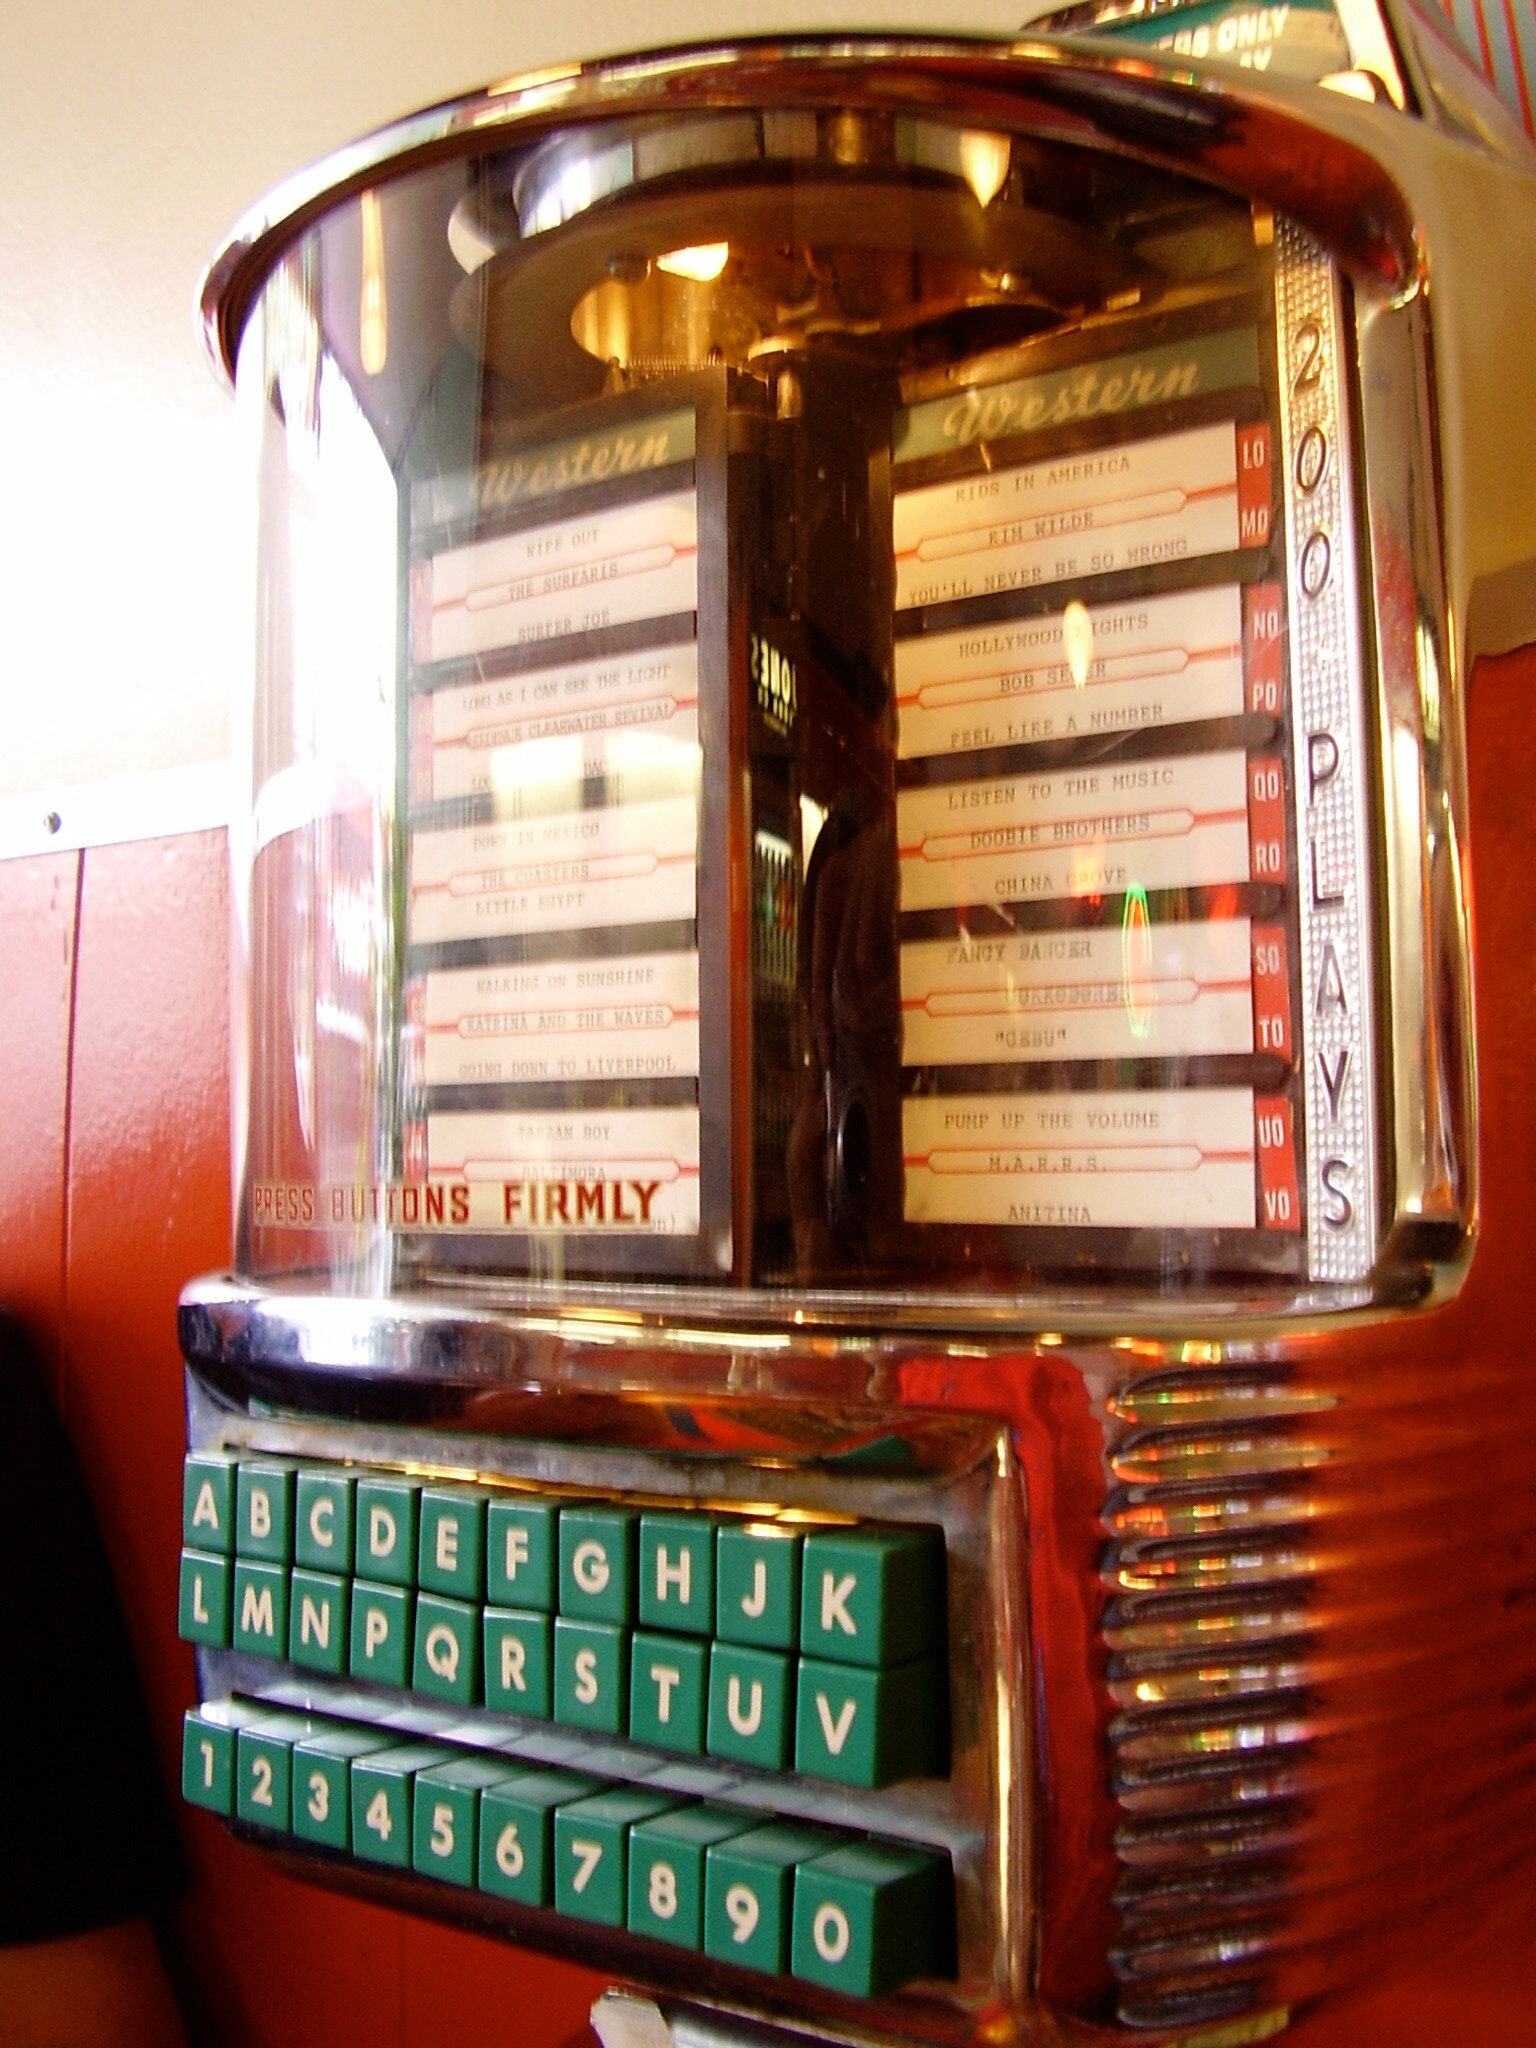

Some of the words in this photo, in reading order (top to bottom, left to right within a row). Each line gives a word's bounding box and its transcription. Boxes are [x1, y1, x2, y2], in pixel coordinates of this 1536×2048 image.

[1216, 3, 1290, 53] ONLY
[943, 358, 1199, 446] Western
[475, 429, 670, 507] Western
[955, 480, 1000, 503] KIDS
[1013, 472, 1036, 490] IN
[1047, 455, 1132, 488] AMERICA
[1289, 322, 1332, 600] 200
[571, 528, 601, 546] OUT
[988, 526, 1025, 546] KIM
[1034, 511, 1096, 538] WILDE
[509, 581, 534, 602] THE
[543, 563, 619, 592] SURFARIS
[908, 580, 973, 606] YOU'LL
[984, 566, 1043, 592] NEVER
[1054, 559, 1078, 579] BE
[1090, 553, 1115, 571] SO
[1127, 539, 1189, 564] WRONG
[517, 619, 573, 643] SURFER
[582, 609, 611, 631] JOE
[958, 627, 1065, 659] HOLLYWOOD
[533, 682, 559, 700] CAN
[564, 677, 590, 696] SEE
[597, 672, 621, 690] THE
[627, 663, 672, 685] LIGHT
[999, 674, 1035, 693] BOB
[528, 712, 607, 738] CLEARWATER
[614, 702, 671, 726] REVIVAL
[949, 728, 996, 750] FEEL
[1006, 719, 1055, 740] LIKE
[1066, 717, 1079, 732] A
[1090, 703, 1164, 730] NUMBER
[947, 787, 1016, 811] LISTEN
[1028, 782, 1053, 800] TO
[1064, 777, 1100, 797] THE
[1112, 767, 1175, 789] MUSIC
[542, 823, 600, 843] MEXICO
[969, 826, 1041, 851] DOOBIE
[1052, 815, 1151, 843] BROTHERS
[480, 870, 507, 890] THE
[514, 863, 590, 886] COASTERS
[994, 875, 1054, 896] CHINA
[475, 897, 529, 916] LITTLE
[537, 891, 587, 910] EGYPT
[476, 975, 539, 995] WALKING
[547, 974, 567, 990] ON
[576, 967, 655, 987] SUNSHINE
[1304, 732, 1354, 1237] PLAYS
[466, 1014, 528, 1034] KATRINA
[537, 1013, 567, 1030] AND
[576, 1011, 605, 1028] THE
[614, 1008, 665, 1025] WAVES
[458, 1062, 502, 1079] GOING
[510, 1061, 549, 1078] DOWN
[559, 1060, 577, 1075] TO
[586, 1056, 677, 1074] LIVERPOOL
[583, 1125, 612, 1141] BOY
[943, 1112, 990, 1131] PUMP
[1001, 1112, 1025, 1130] UP
[1037, 1111, 1073, 1130] THE
[1085, 1110, 1161, 1131] VOLUME
[253, 1185, 315, 1223] PRESS
[331, 1185, 471, 1225] BUTTONS
[504, 1181, 660, 1225] FIRMLY
[1007, 1203, 1093, 1224] ANITINA
[191, 1480, 219, 1531] A
[249, 1487, 273, 1539] B
[309, 1497, 335, 1548] C
[369, 1505, 397, 1559] D
[435, 1515, 460, 1573] E
[505, 1525, 530, 1581] F
[572, 1539, 611, 1595] G
[655, 1542, 692, 1605] H
[741, 1558, 767, 1619] J
[820, 1570, 858, 1637] K
[193, 1574, 209, 1625] L
[241, 1583, 275, 1637] M
[301, 1594, 331, 1649] N
[365, 1609, 389, 1659] P
[425, 1623, 460, 1683] Q
[501, 1634, 527, 1692] R
[574, 1648, 599, 1705] S
[650, 1663, 681, 1723] T
[727, 1675, 763, 1737] U
[815, 1693, 857, 1756] V
[201, 1739, 215, 1789] 1
[251, 1756, 273, 1807] 2
[307, 1770, 331, 1823] 3
[365, 1789, 393, 1841] 4
[429, 1803, 455, 1858] 5
[495, 1823, 524, 1877] 6
[571, 1840, 603, 1895] 7
[647, 1859, 679, 1920] 8
[725, 1883, 760, 1945] 9
[812, 1902, 850, 1964] 0
